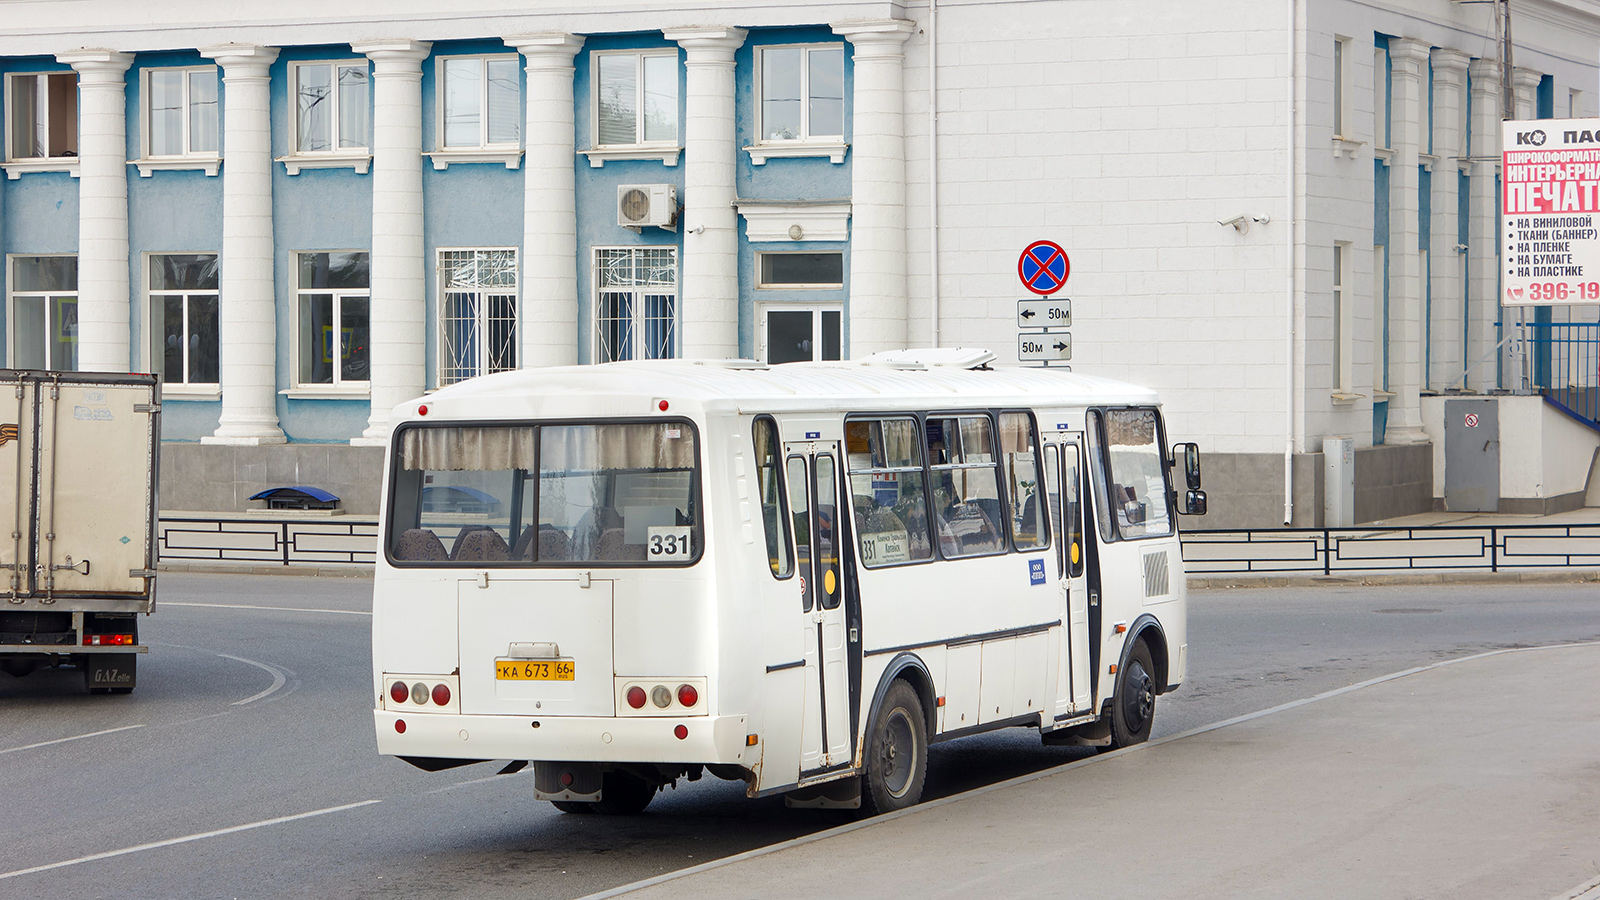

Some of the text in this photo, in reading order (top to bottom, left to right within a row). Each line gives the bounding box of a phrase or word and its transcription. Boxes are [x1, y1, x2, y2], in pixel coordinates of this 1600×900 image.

[1507, 181, 1600, 212] ПЕЧАТ
[1517, 214, 1592, 229] НА ВИНИЛОВОЙ
[1517, 229, 1598, 241] ТКАНИ (БАННЕР)
[1517, 242, 1570, 253] НА ПЛЕНКЕ
[1517, 254, 1572, 265] НА БУМАГЕ
[1517, 266, 1583, 277] НА ПЛАСТИКЕ
[1529, 282, 1600, 301] 396-19
[650, 534, 687, 555] 331
[863, 540, 876, 560] 331
[503, 663, 570, 678] КА 673 66
